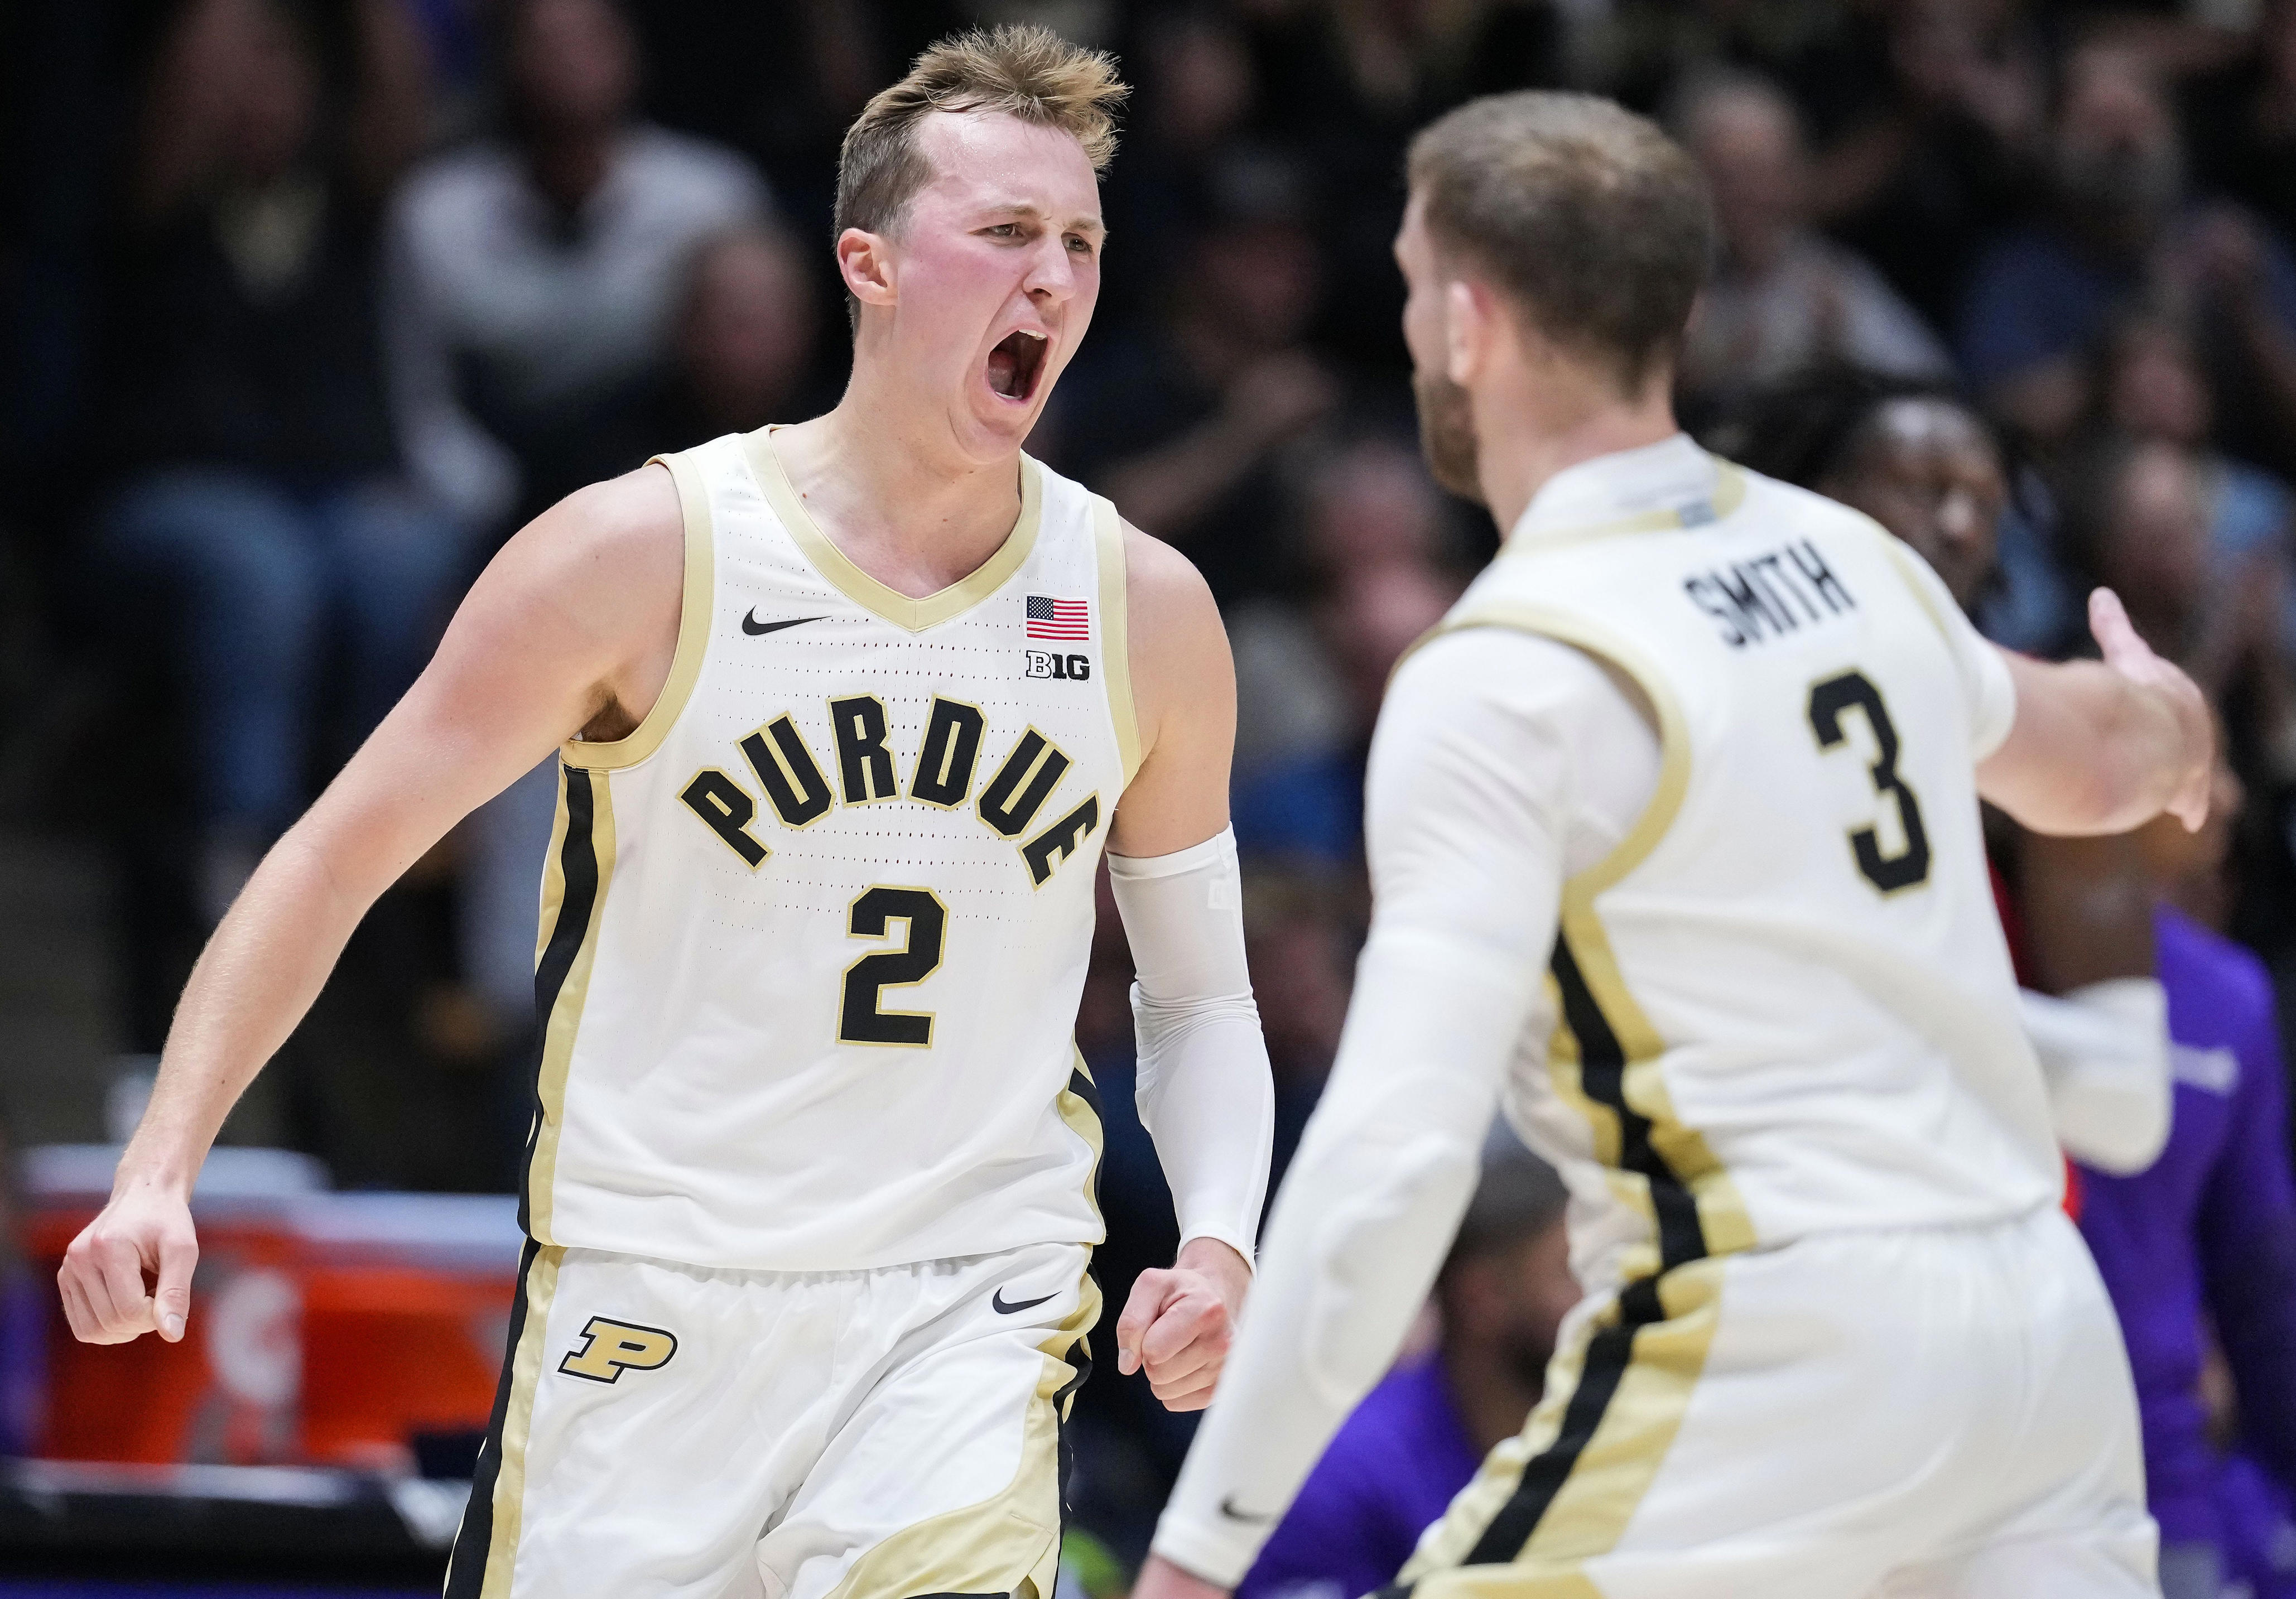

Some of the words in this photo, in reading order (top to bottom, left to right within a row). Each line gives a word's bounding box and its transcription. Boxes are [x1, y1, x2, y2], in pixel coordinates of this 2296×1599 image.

[1683, 539, 1856, 648] SMITH
[675, 691, 1102, 892] PURDUE
[1804, 666, 1933, 898] 3
[836, 883, 950, 1051] 2
[557, 1314, 678, 1385] P
